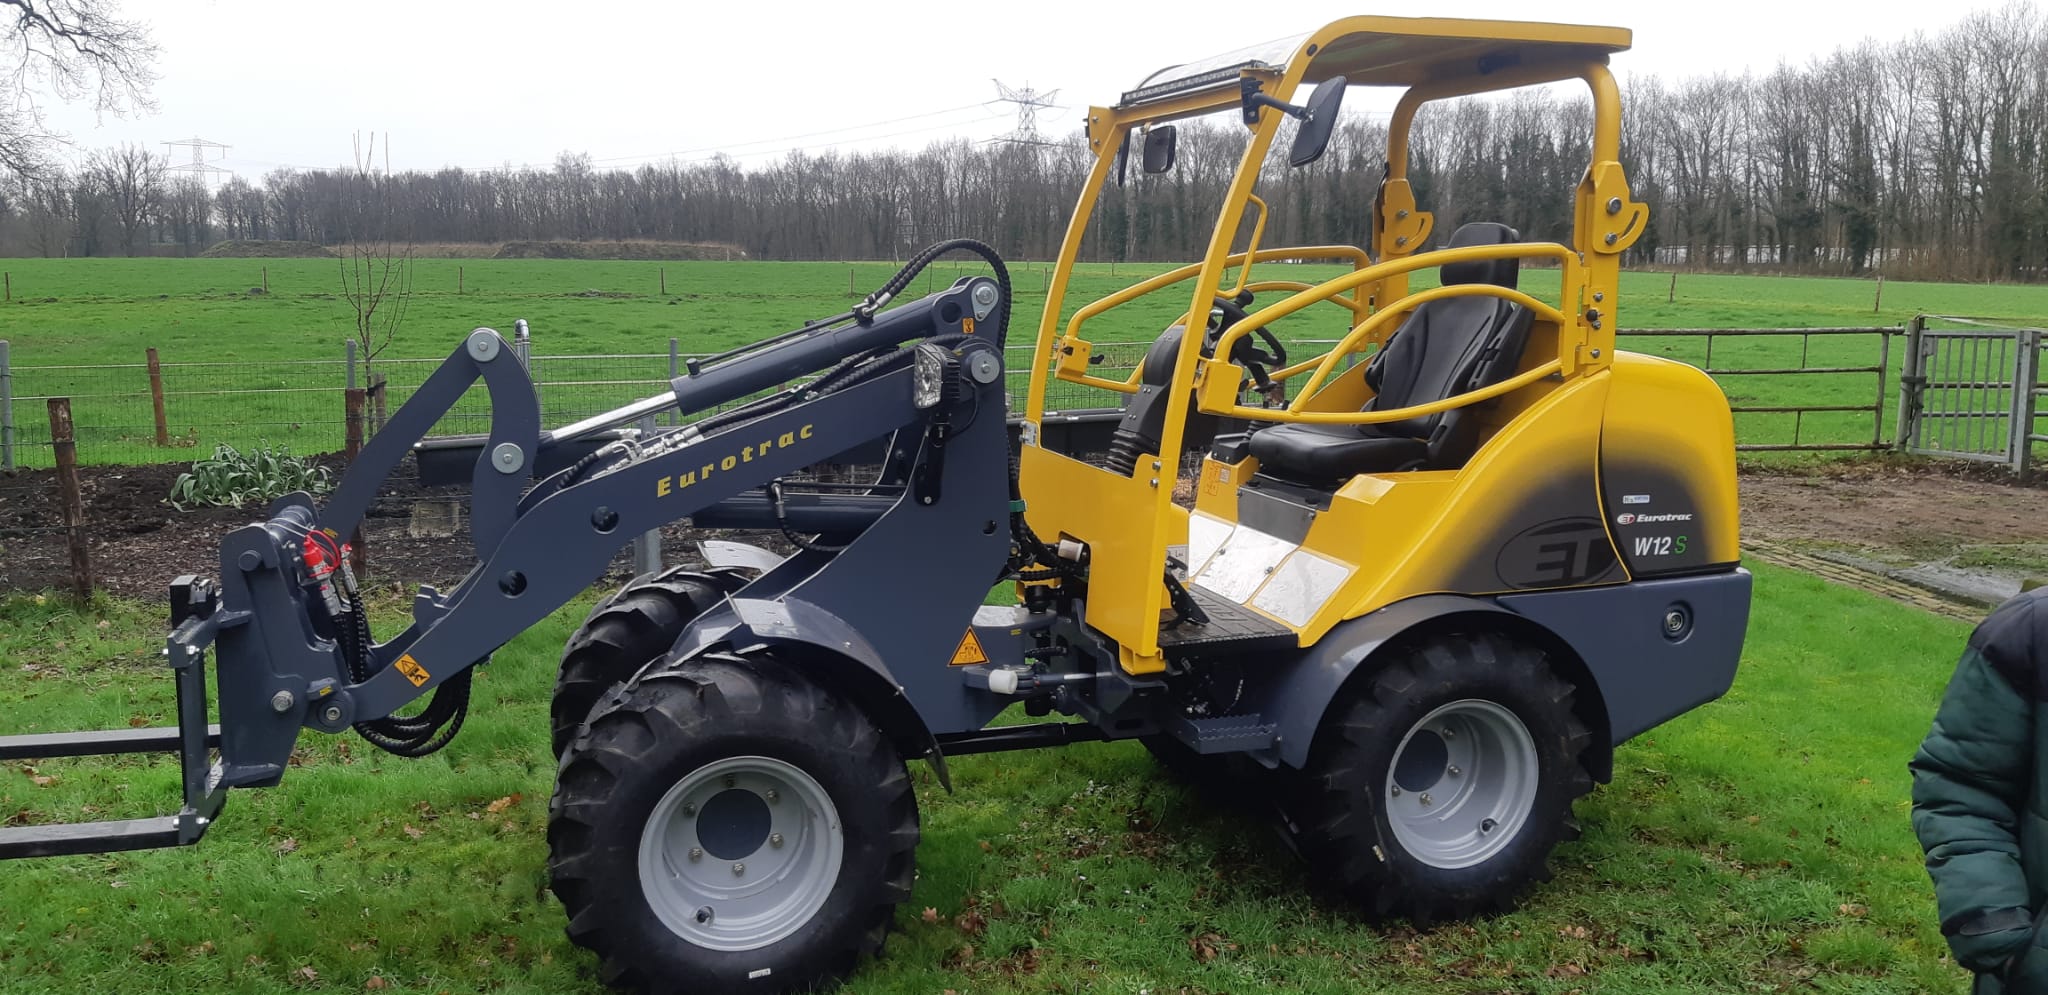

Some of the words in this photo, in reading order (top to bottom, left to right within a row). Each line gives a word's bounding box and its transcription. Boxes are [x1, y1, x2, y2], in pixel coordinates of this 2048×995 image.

[656, 423, 814, 498] Eurotrac
[1636, 513, 1693, 523] Eurotrac
[1635, 536, 1672, 556] W12
[1674, 535, 1688, 555] S
